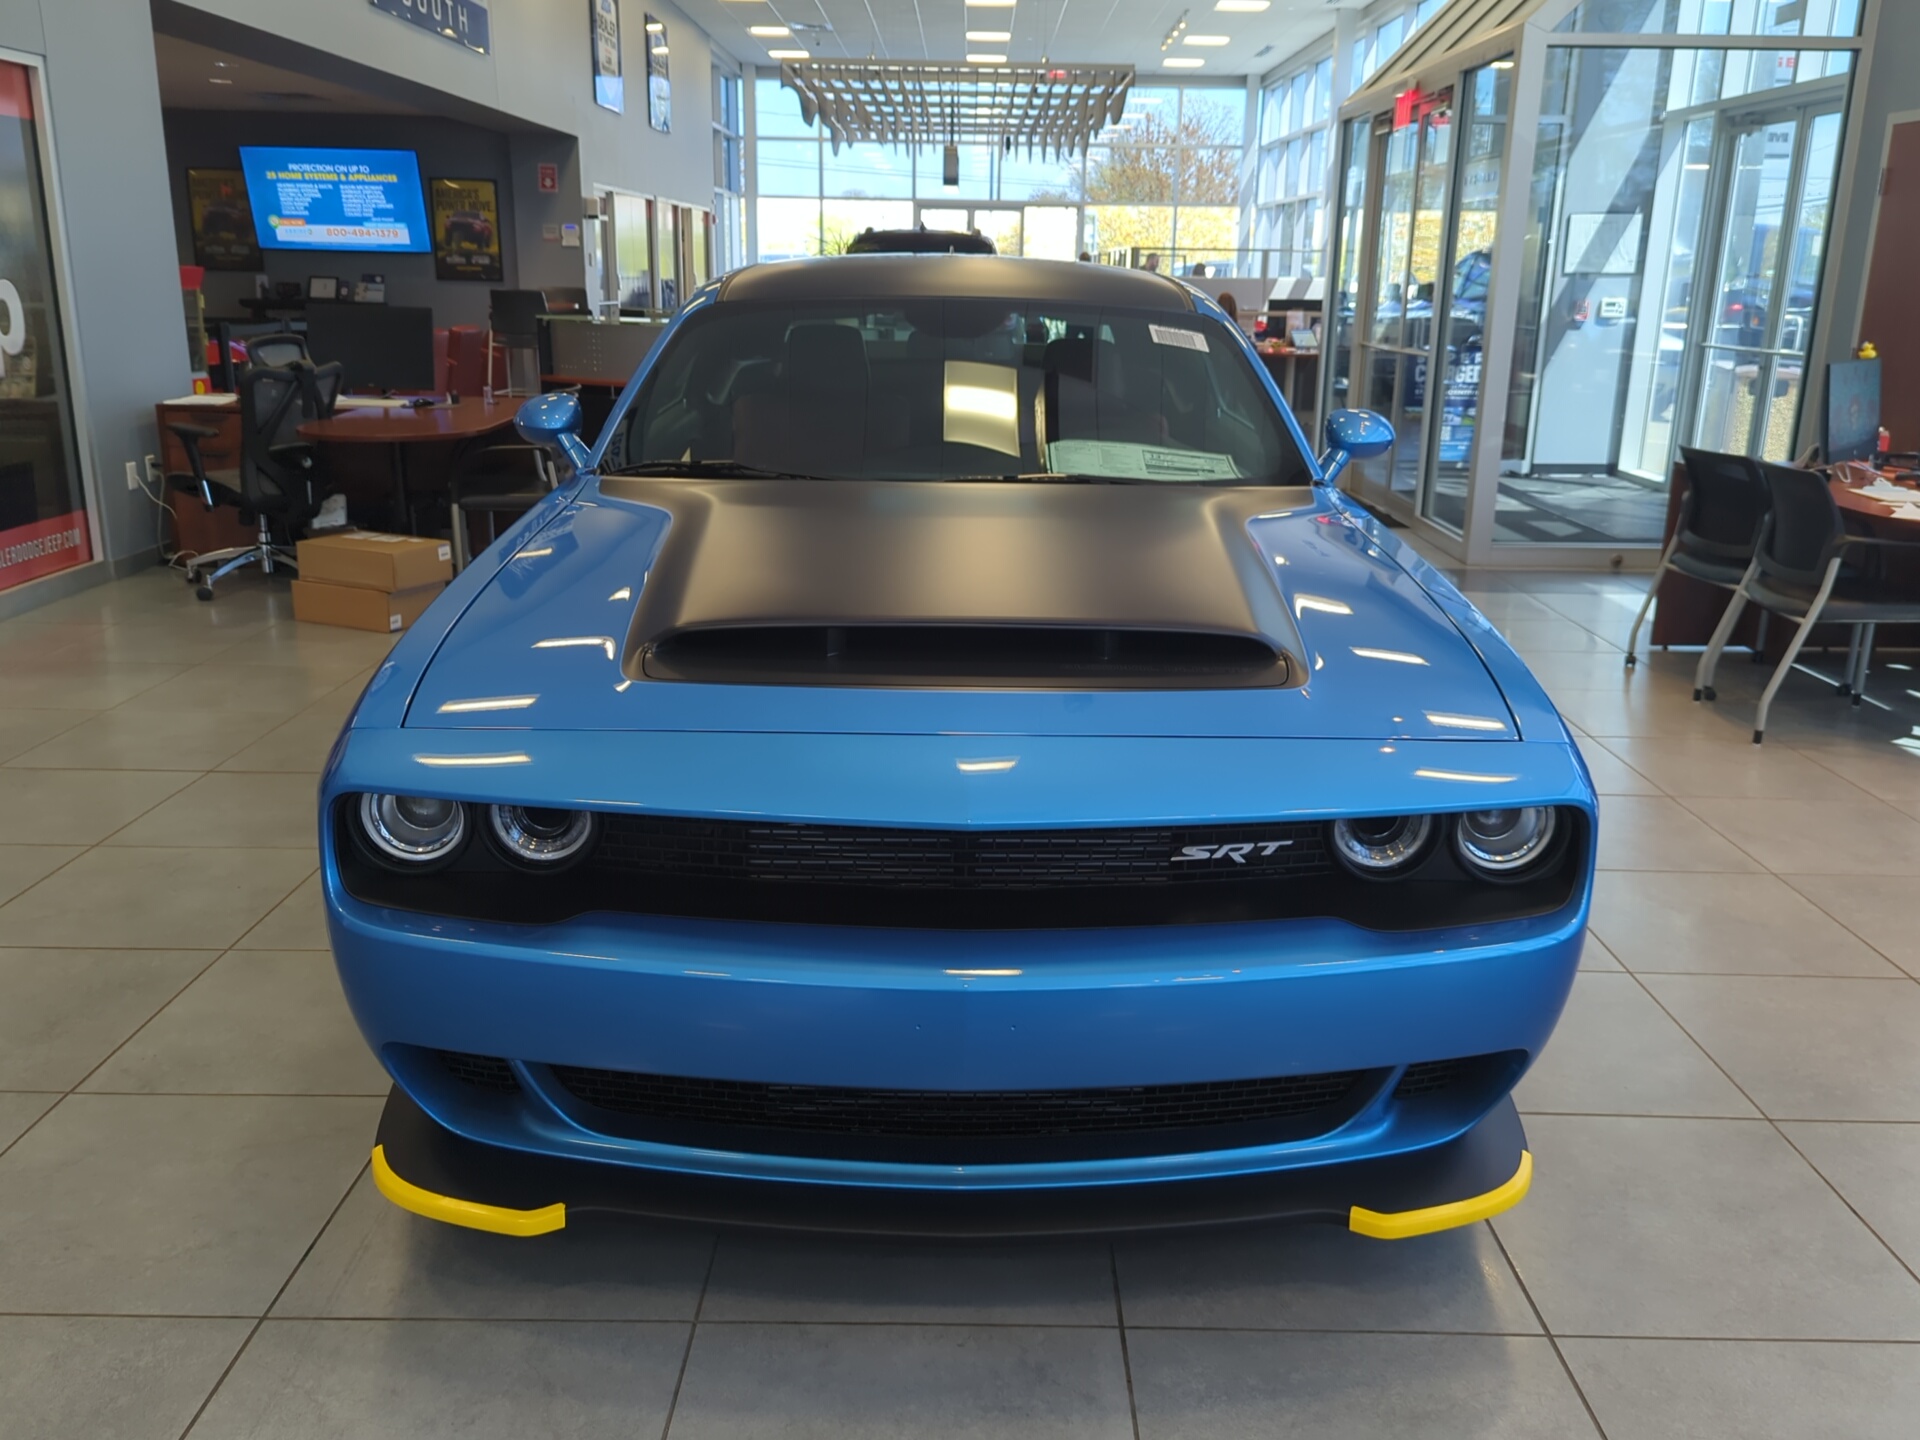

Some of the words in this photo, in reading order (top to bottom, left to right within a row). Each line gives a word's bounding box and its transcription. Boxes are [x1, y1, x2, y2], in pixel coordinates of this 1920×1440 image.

[402, 0, 468, 33] OUTH
[288, 163, 334, 173] PROTECTION
[334, 164, 348, 173] ON
[348, 165, 359, 173] UP
[359, 165, 369, 174] TO
[278, 171, 302, 180] HOME
[304, 172, 338, 181] SYSTEMS
[348, 173, 398, 183] APPLIANCES
[326, 227, 399, 238] 800-494-1379
[1170, 840, 1294, 864] SRT
